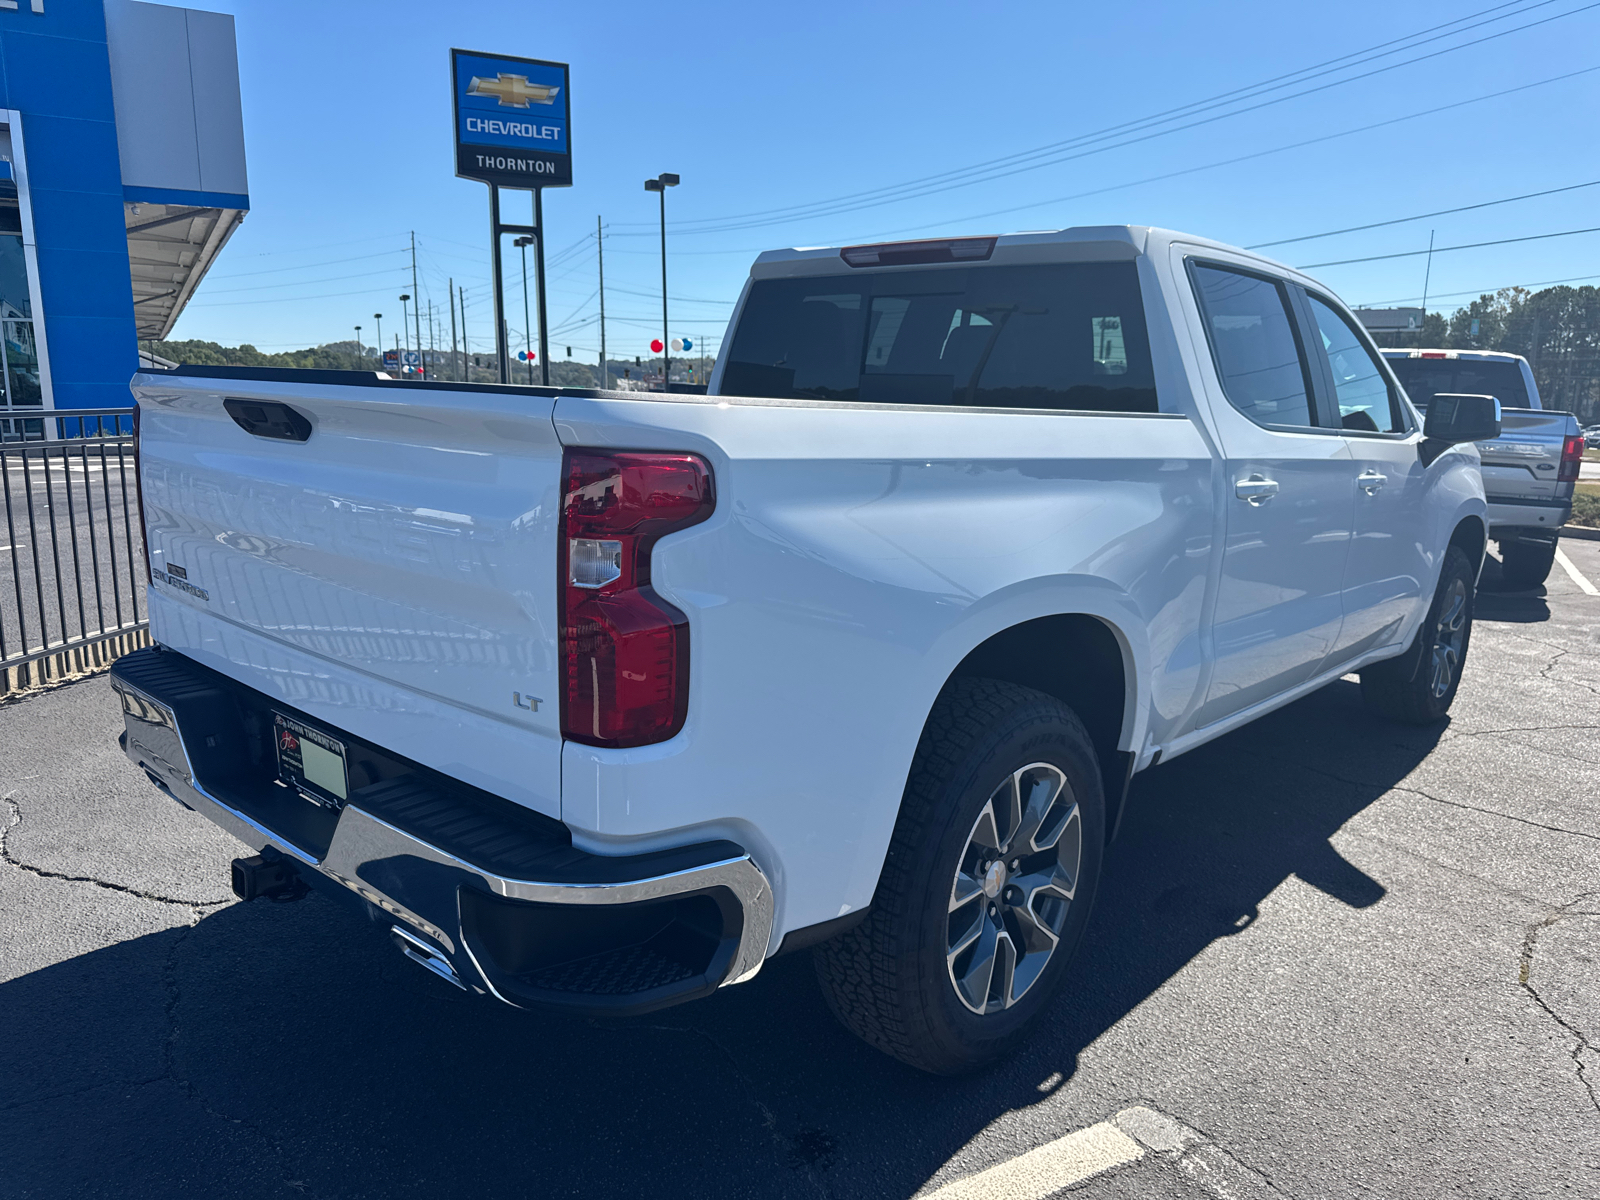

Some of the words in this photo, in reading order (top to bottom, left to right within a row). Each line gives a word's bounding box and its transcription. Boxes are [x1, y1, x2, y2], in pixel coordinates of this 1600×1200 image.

[466, 118, 561, 140] CHEVROLET
[476, 155, 555, 174] THORNTON
[513, 691, 543, 712] LT
[287, 720, 304, 736] JOHN
[304, 729, 340, 753] THORNTON
